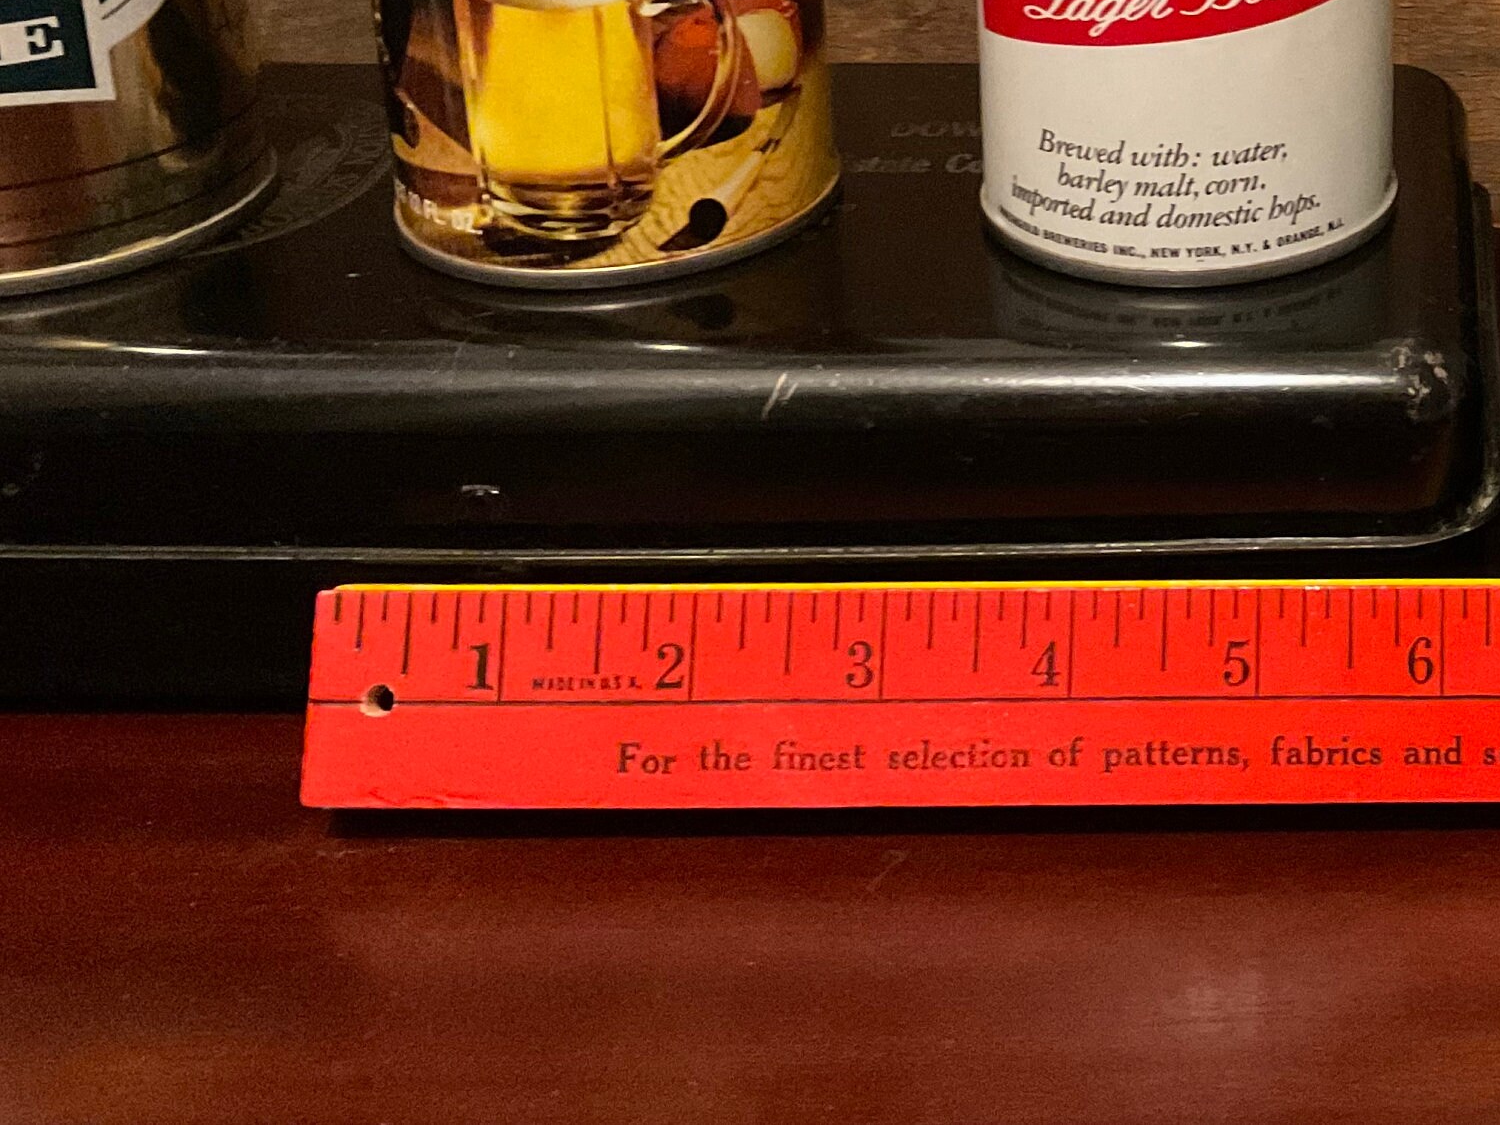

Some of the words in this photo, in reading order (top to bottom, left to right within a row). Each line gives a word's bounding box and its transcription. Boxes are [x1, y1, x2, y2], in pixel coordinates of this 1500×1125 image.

[1039, 128, 1125, 166] Brewed
[1131, 143, 1201, 168] with:
[1012, 175, 1096, 221] imported
[1099, 202, 1151, 228] and
[1155, 199, 1265, 229] domestic
[1268, 193, 1321, 226] hops.
[1056, 162, 1129, 204] barley
[1133, 173, 1199, 201] malt,
[1042, 228, 1109, 255] BREWERIES
[1150, 246, 1181, 259] NEW
[1231, 242, 1258, 255] N.Y.
[1262, 238, 1271, 251] &
[468, 643, 495, 691] 1
[654, 641, 687, 691] 2
[845, 640, 874, 690] 3
[1030, 640, 1062, 688] 4
[1222, 639, 1251, 688] 5
[1406, 636, 1435, 685] 6
[616, 741, 677, 775] For
[700, 742, 752, 773] the
[772, 738, 866, 773] finest
[888, 738, 1031, 771] selection
[1048, 736, 1085, 769] of
[1101, 738, 1251, 774] patterns,
[1270, 735, 1384, 768] fabrics
[1403, 735, 1463, 768] and
